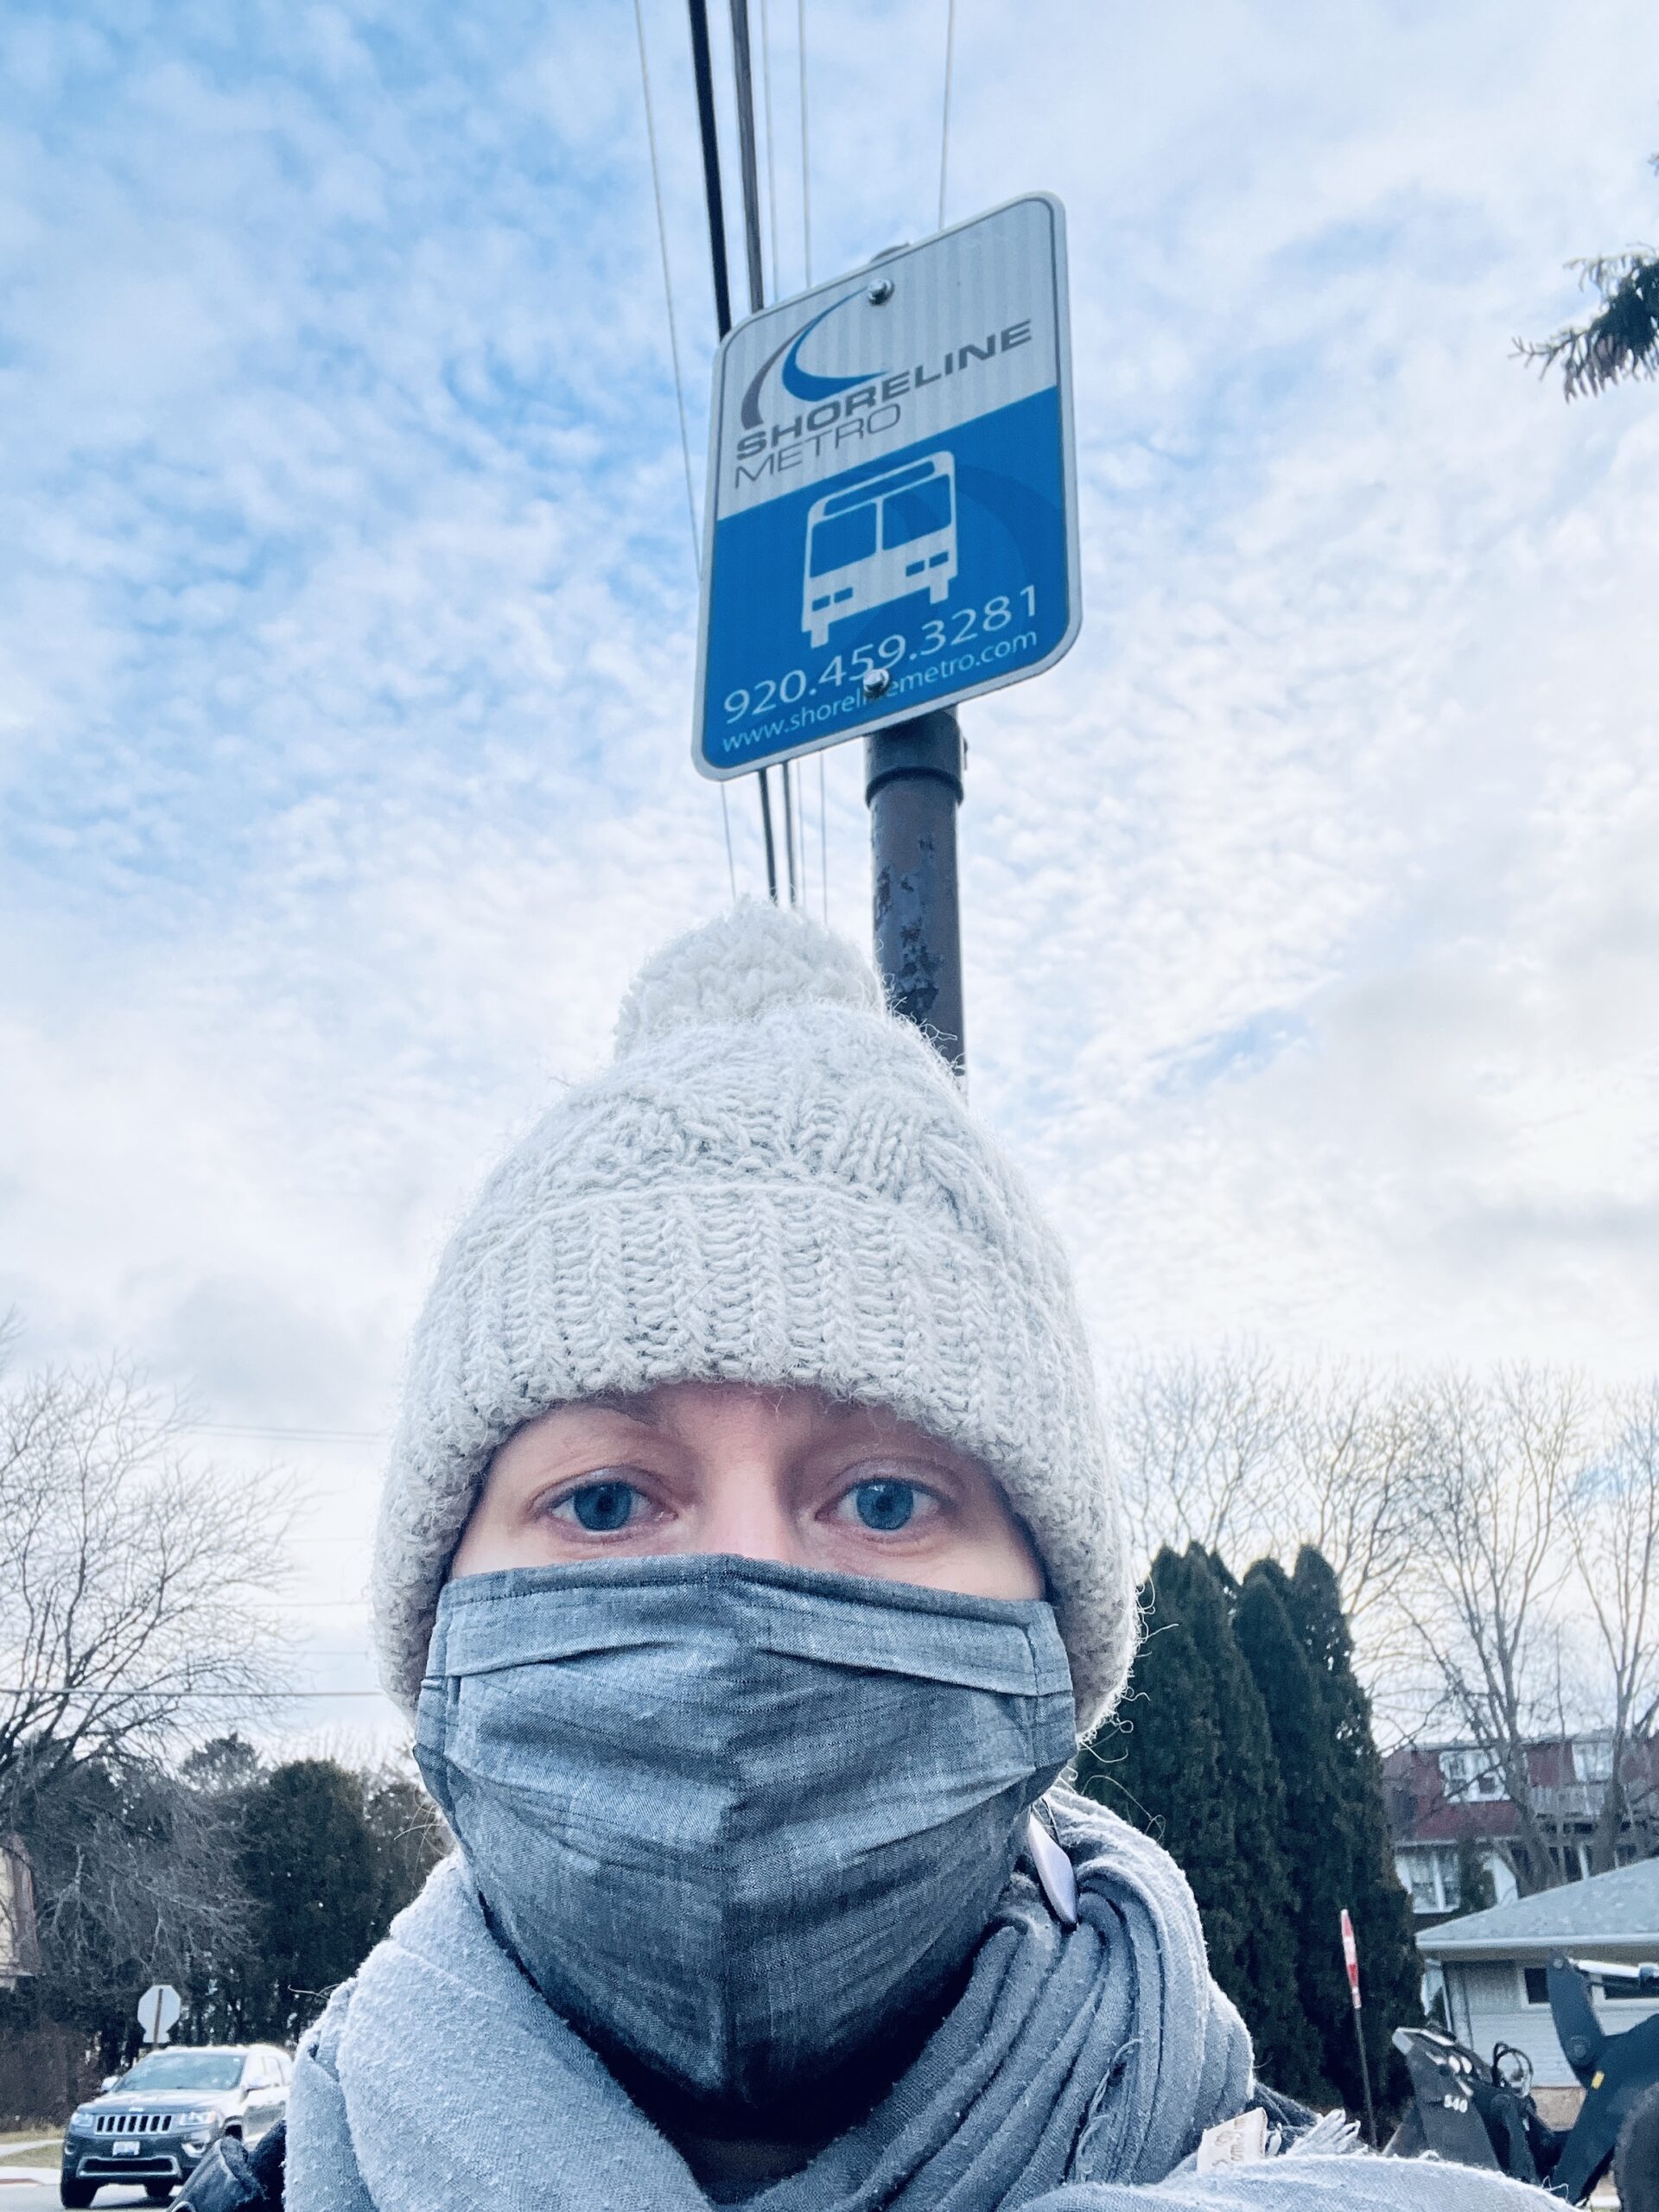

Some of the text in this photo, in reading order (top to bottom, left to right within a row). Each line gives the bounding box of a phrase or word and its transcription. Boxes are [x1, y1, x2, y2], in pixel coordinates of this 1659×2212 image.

[734, 404, 900, 489] METRO
[737, 319, 1032, 461] SHORELINE
[723, 584, 1036, 724] 920.459.3281
